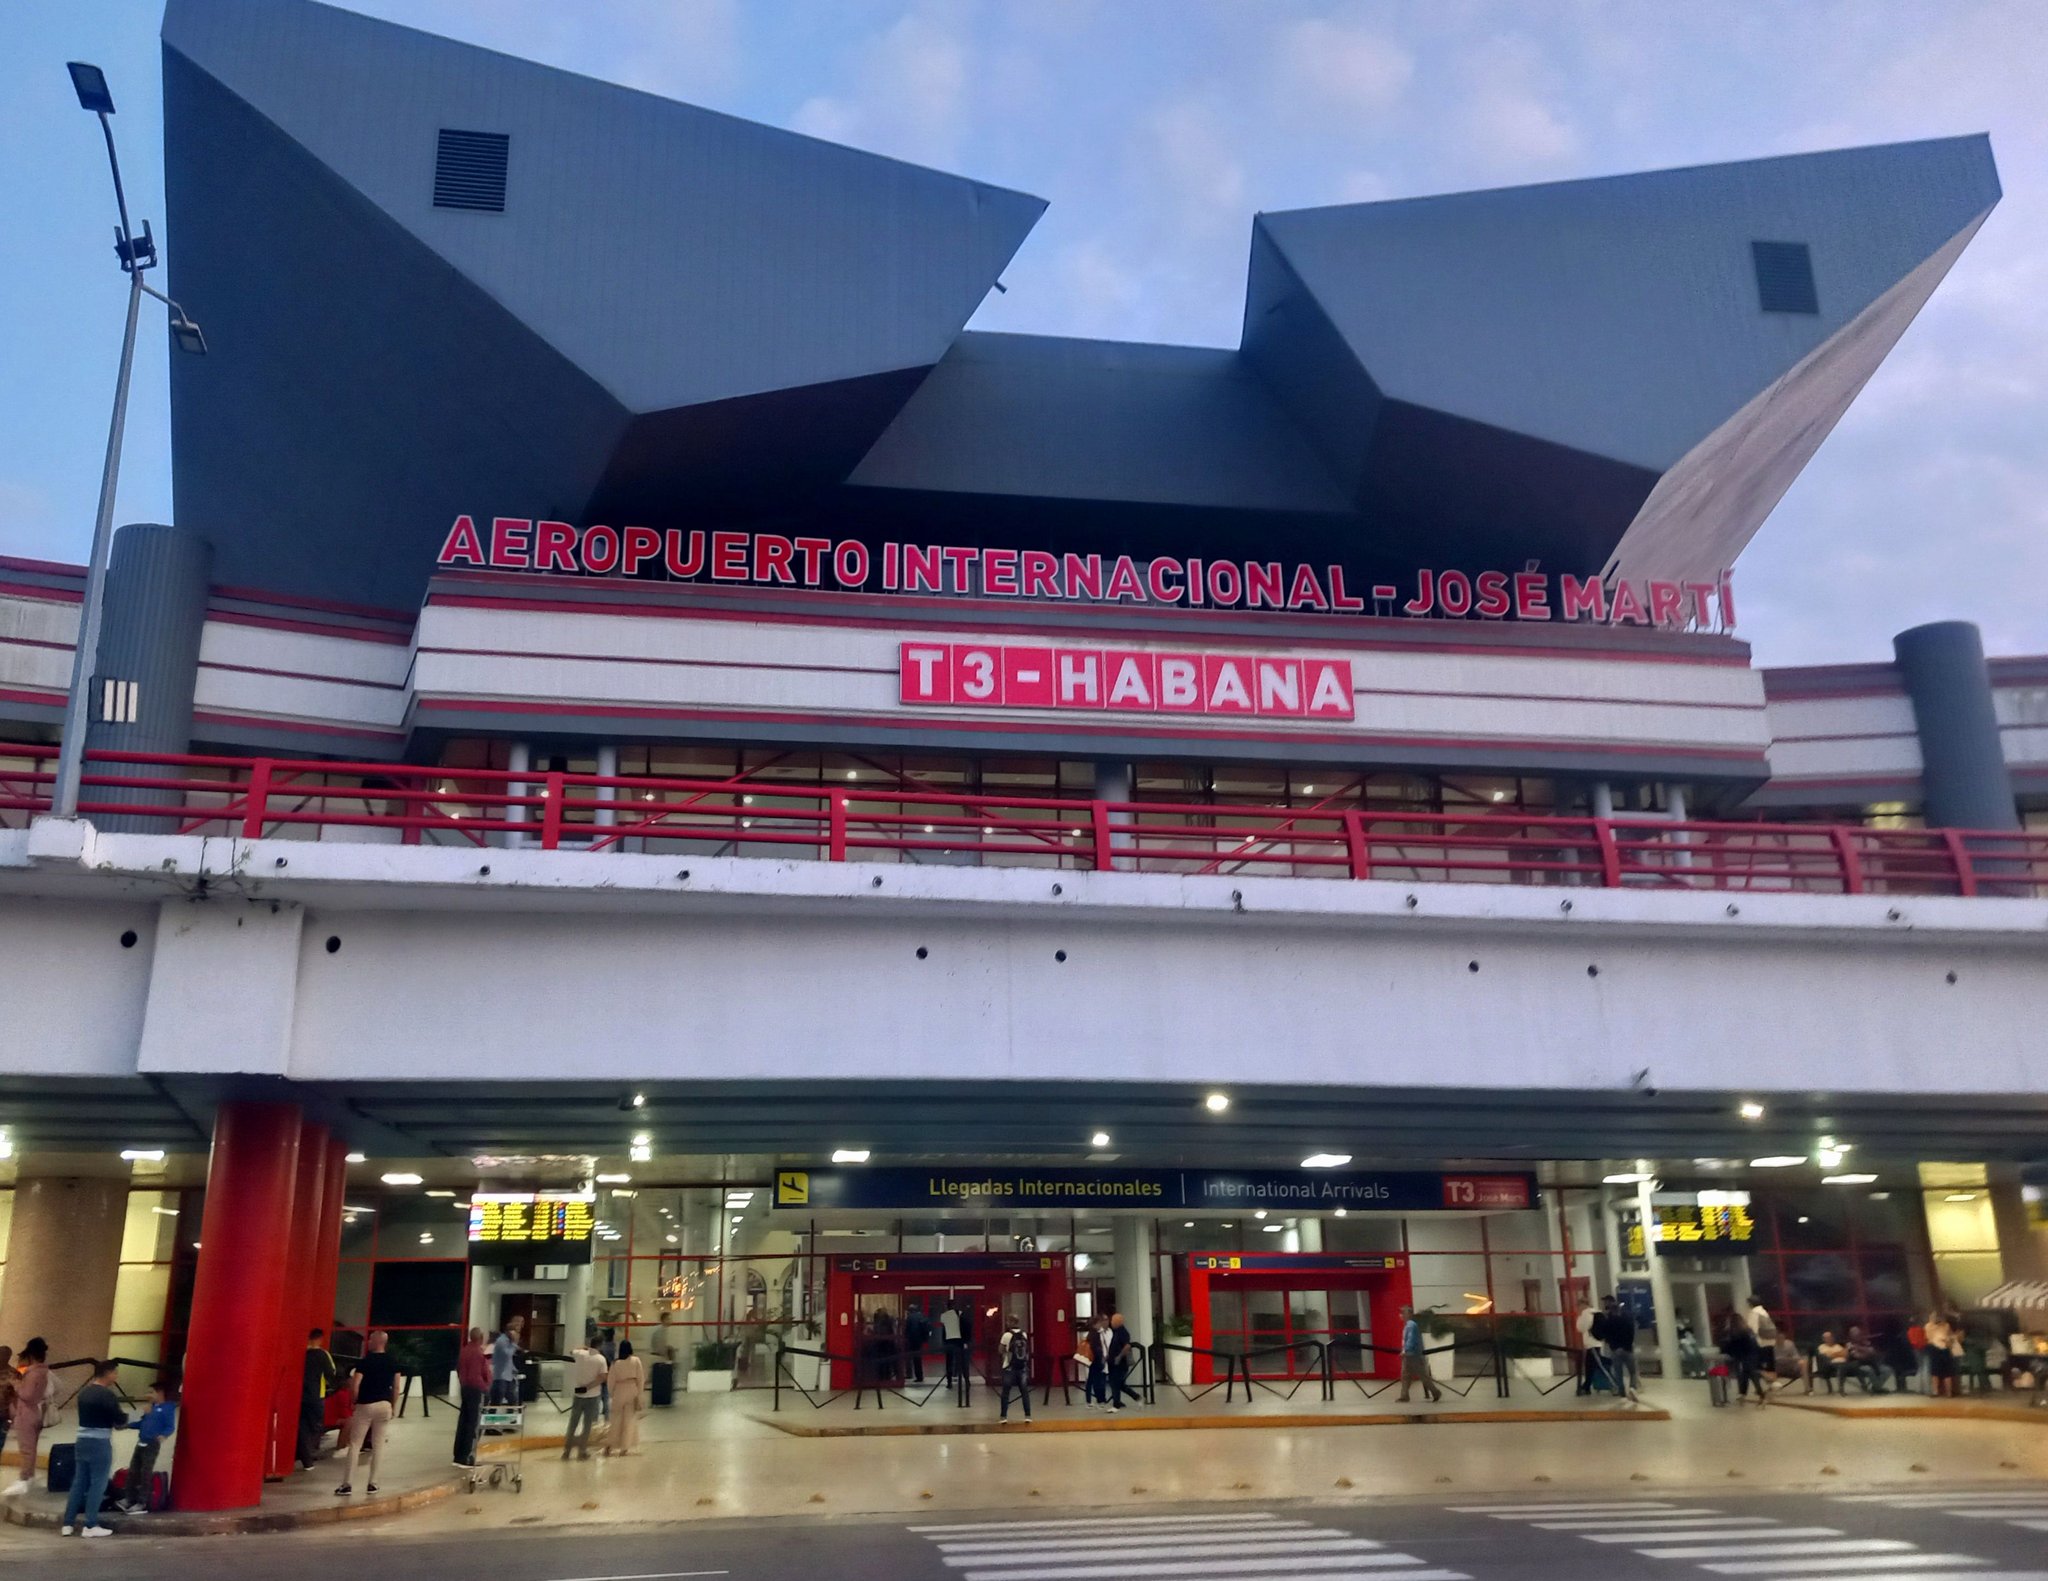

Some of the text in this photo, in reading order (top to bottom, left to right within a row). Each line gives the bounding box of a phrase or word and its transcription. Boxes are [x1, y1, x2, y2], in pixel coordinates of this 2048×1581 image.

[436, 514, 1737, 629] AEROPUERTO INTERNACIONAL - JOSÉ MARTÍ
[1060, 654, 1351, 712] HABANA
[929, 1177, 1163, 1199] Llegadas Internacionales
[1203, 1179, 1390, 1199] International Arrivals
[1447, 1181, 1475, 1202] T3
[852, 1259, 861, 1271] C
